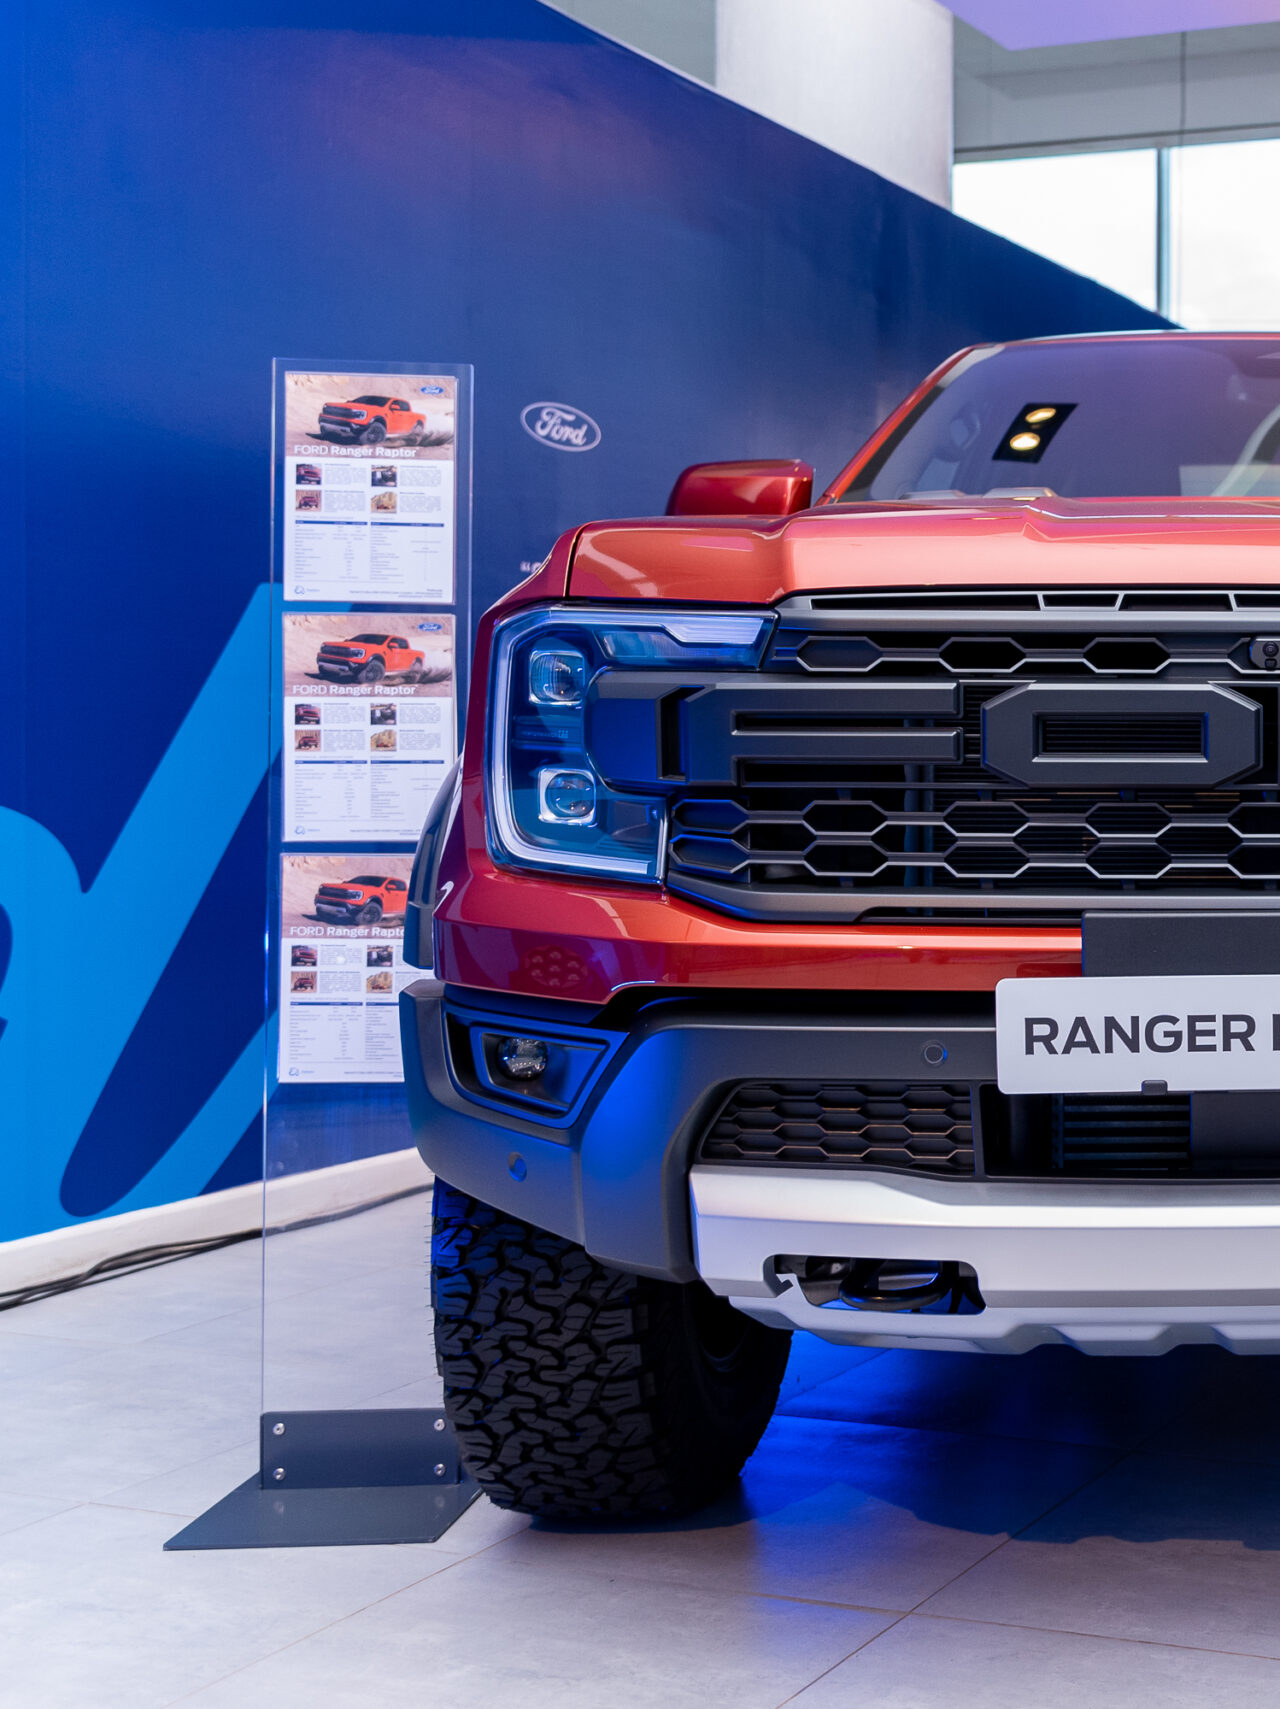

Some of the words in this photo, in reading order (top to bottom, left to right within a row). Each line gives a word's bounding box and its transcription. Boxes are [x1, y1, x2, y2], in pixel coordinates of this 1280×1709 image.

[535, 408, 587, 446] Ford
[294, 446, 328, 455] FORD
[330, 446, 373, 458] Ranger
[375, 447, 416, 458] Raptor
[293, 685, 327, 694] FORD
[329, 685, 372, 696] Ranger
[374, 685, 416, 696] Raptor
[290, 927, 324, 936] FORD
[327, 927, 368, 937] Ranger
[1023, 1015, 1257, 1055] RANGER
